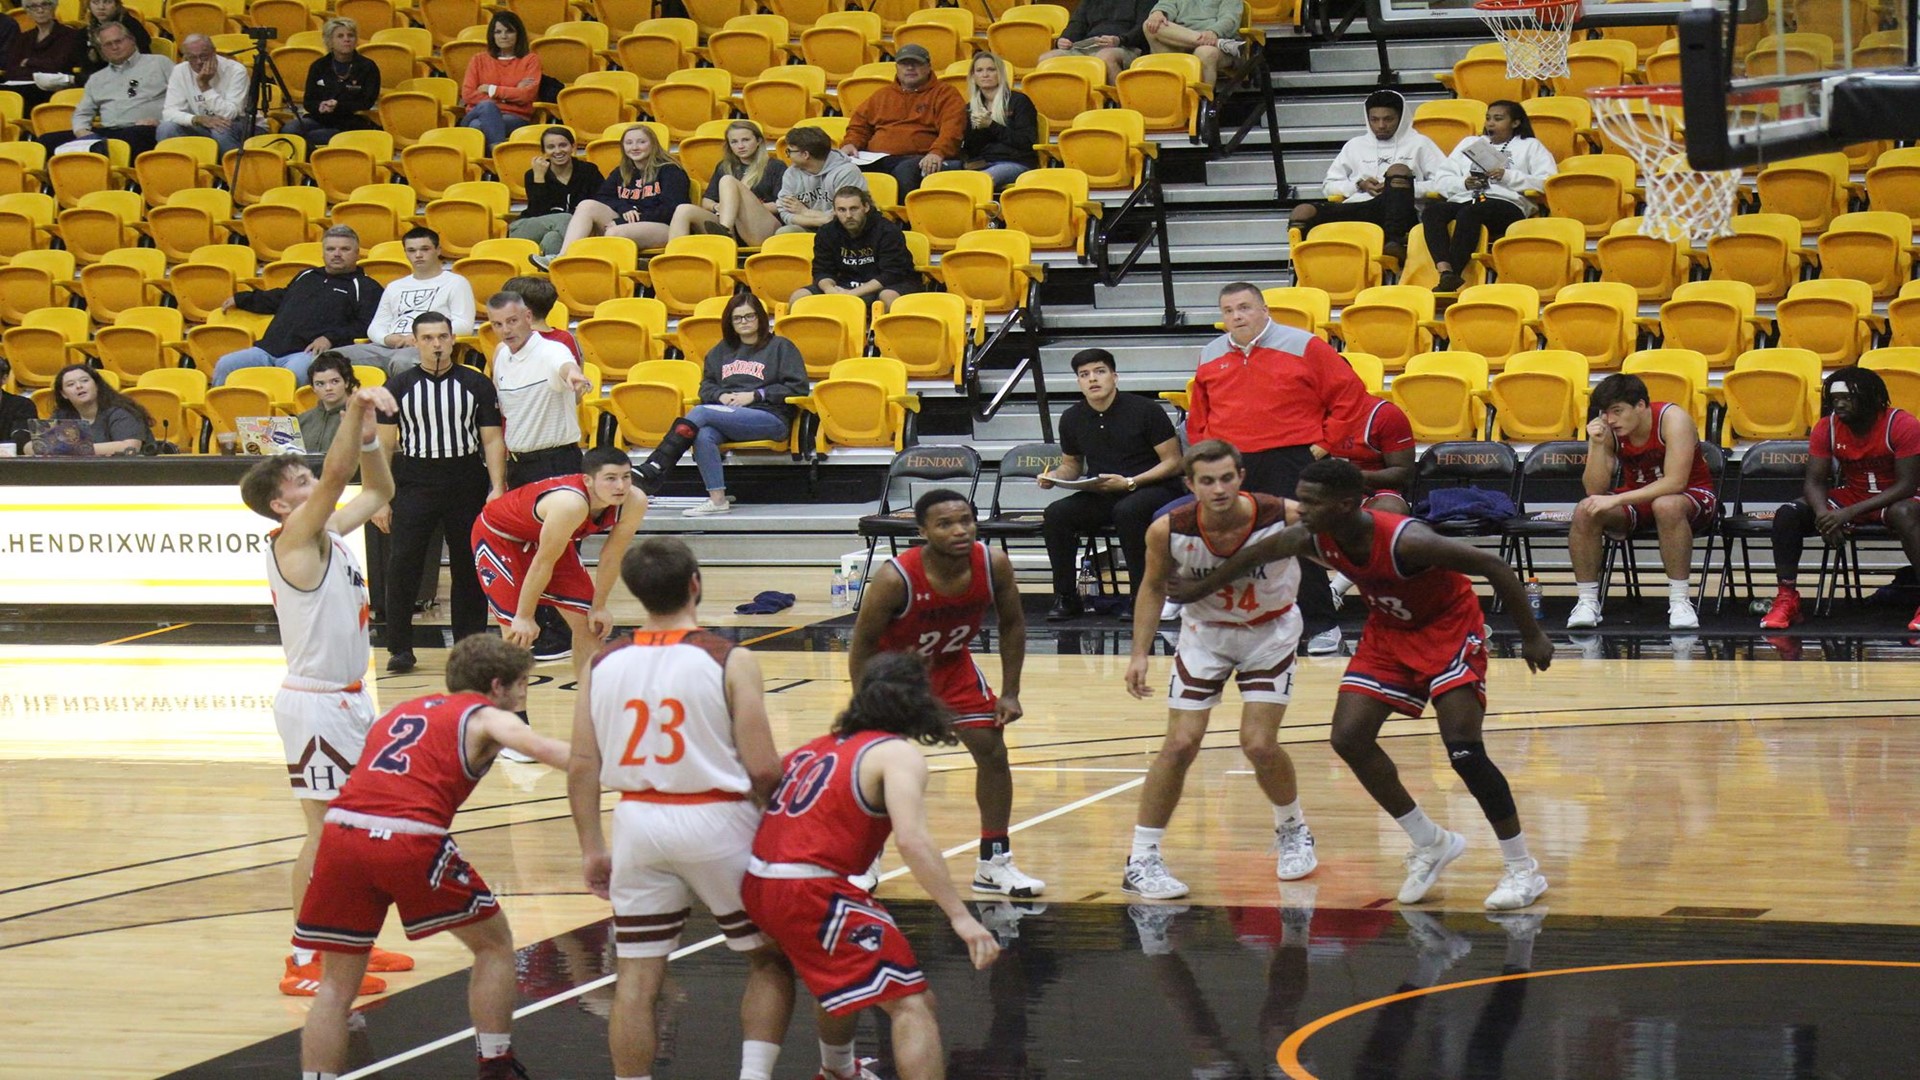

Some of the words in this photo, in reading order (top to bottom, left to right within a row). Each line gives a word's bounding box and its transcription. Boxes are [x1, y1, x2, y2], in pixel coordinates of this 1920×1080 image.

[906, 455, 967, 468] HENDRIX
[1017, 455, 1064, 470] HENDR
[1437, 453, 1500, 465] HENDRIX
[1543, 453, 1588, 465] HEND
[1760, 452, 1810, 465] HENDR
[1215, 581, 1260, 613] 34
[916, 624, 972, 658] 22
[368, 713, 428, 776] 2
[618, 697, 687, 767] 23
[308, 765, 337, 792] H
[766, 750, 839, 818] 10
